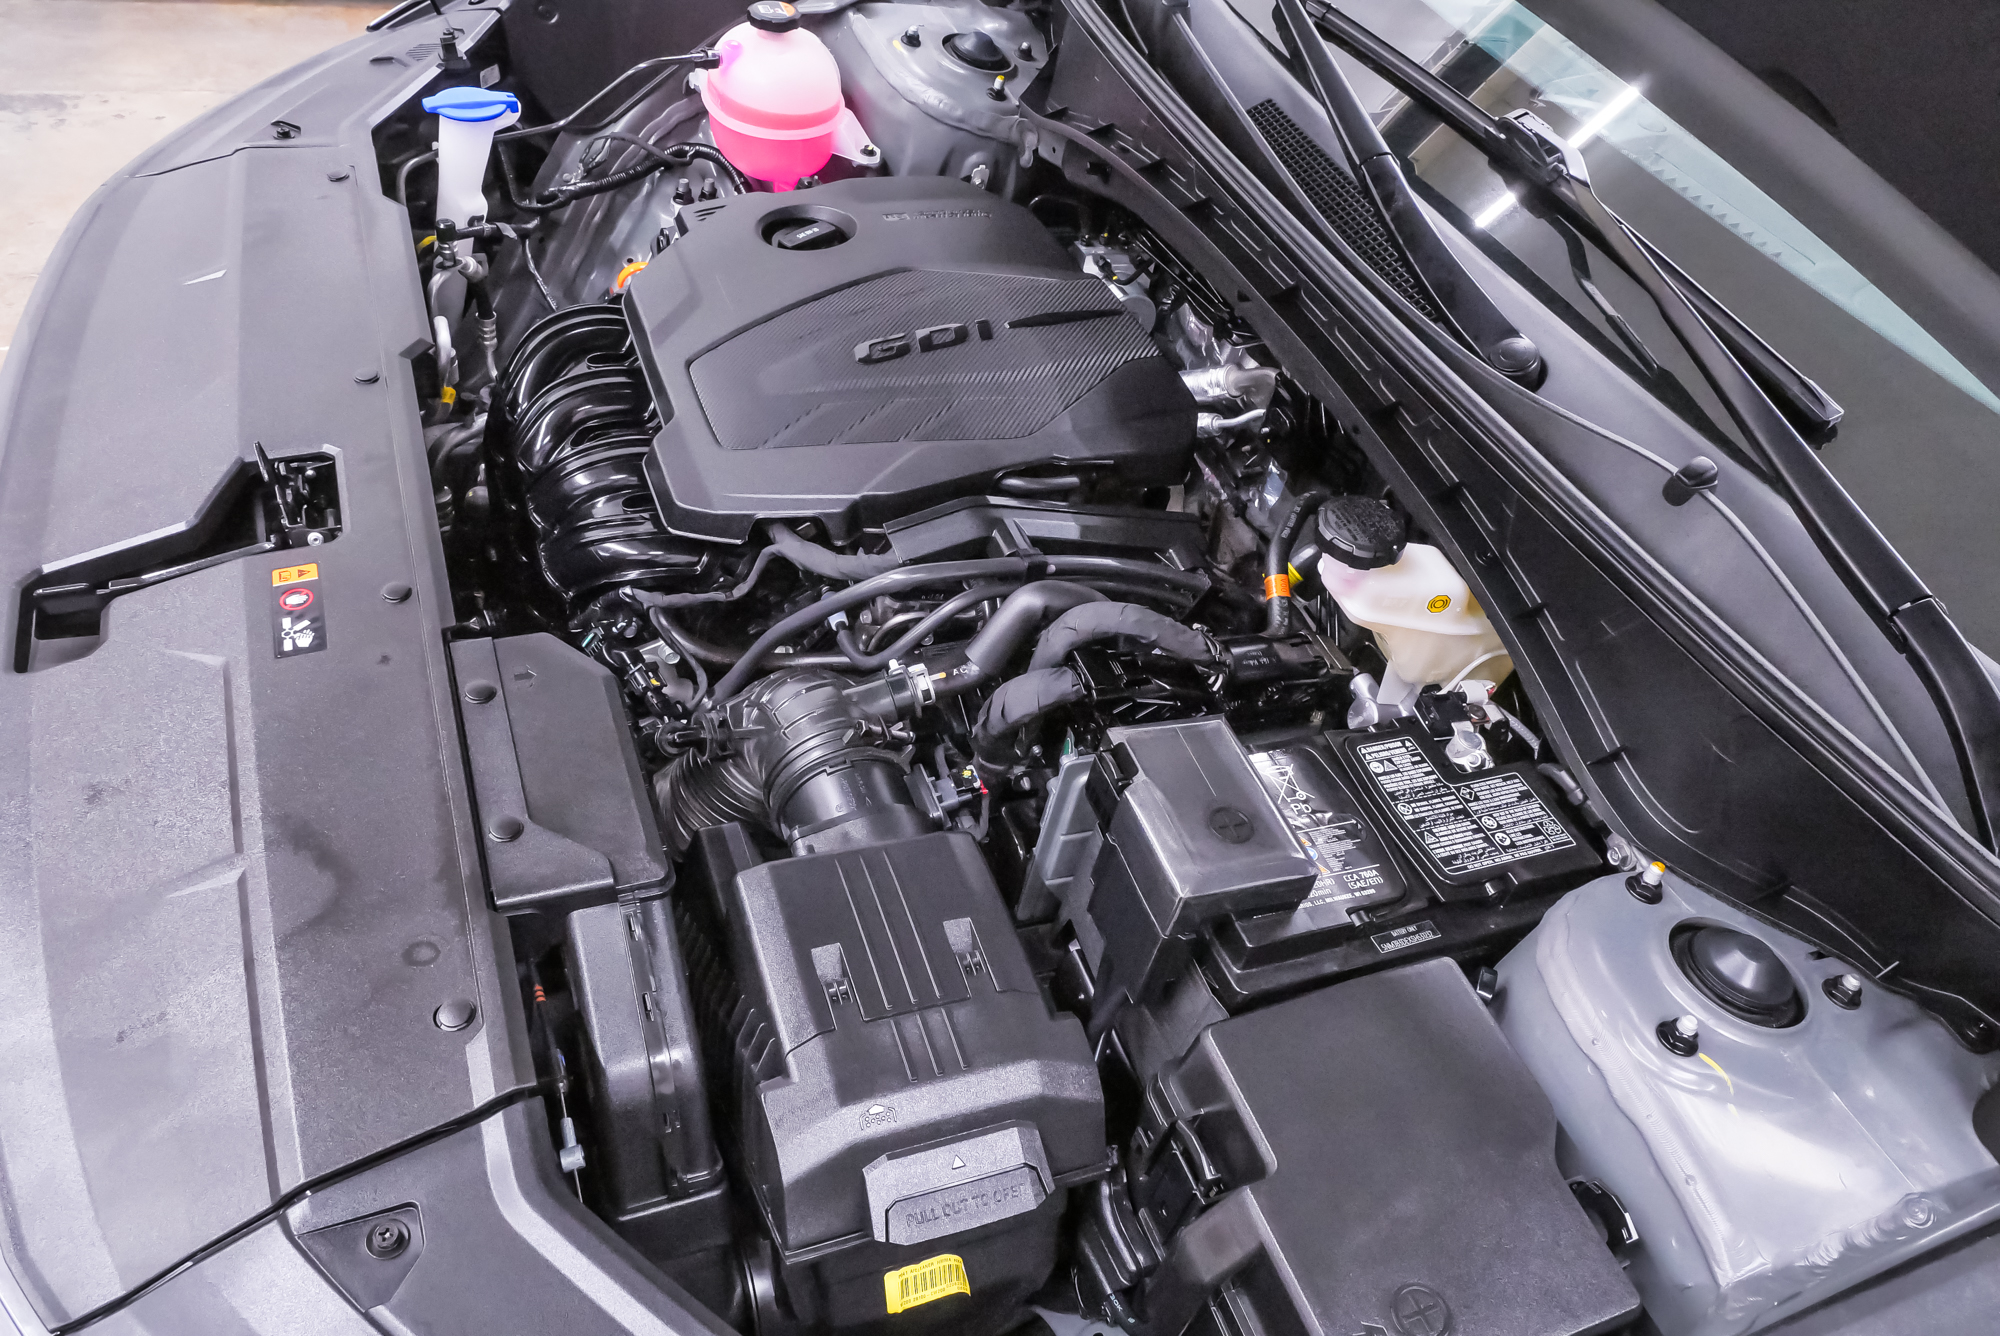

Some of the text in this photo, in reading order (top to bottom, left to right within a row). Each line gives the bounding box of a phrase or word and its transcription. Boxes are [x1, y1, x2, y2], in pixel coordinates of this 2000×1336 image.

[1290, 802, 1312, 815] Pb
[1314, 877, 1335, 888] 20HR)
[1342, 873, 1360, 882] CCA
[1308, 887, 1332, 898] 20min
[904, 1207, 940, 1227] PULL
